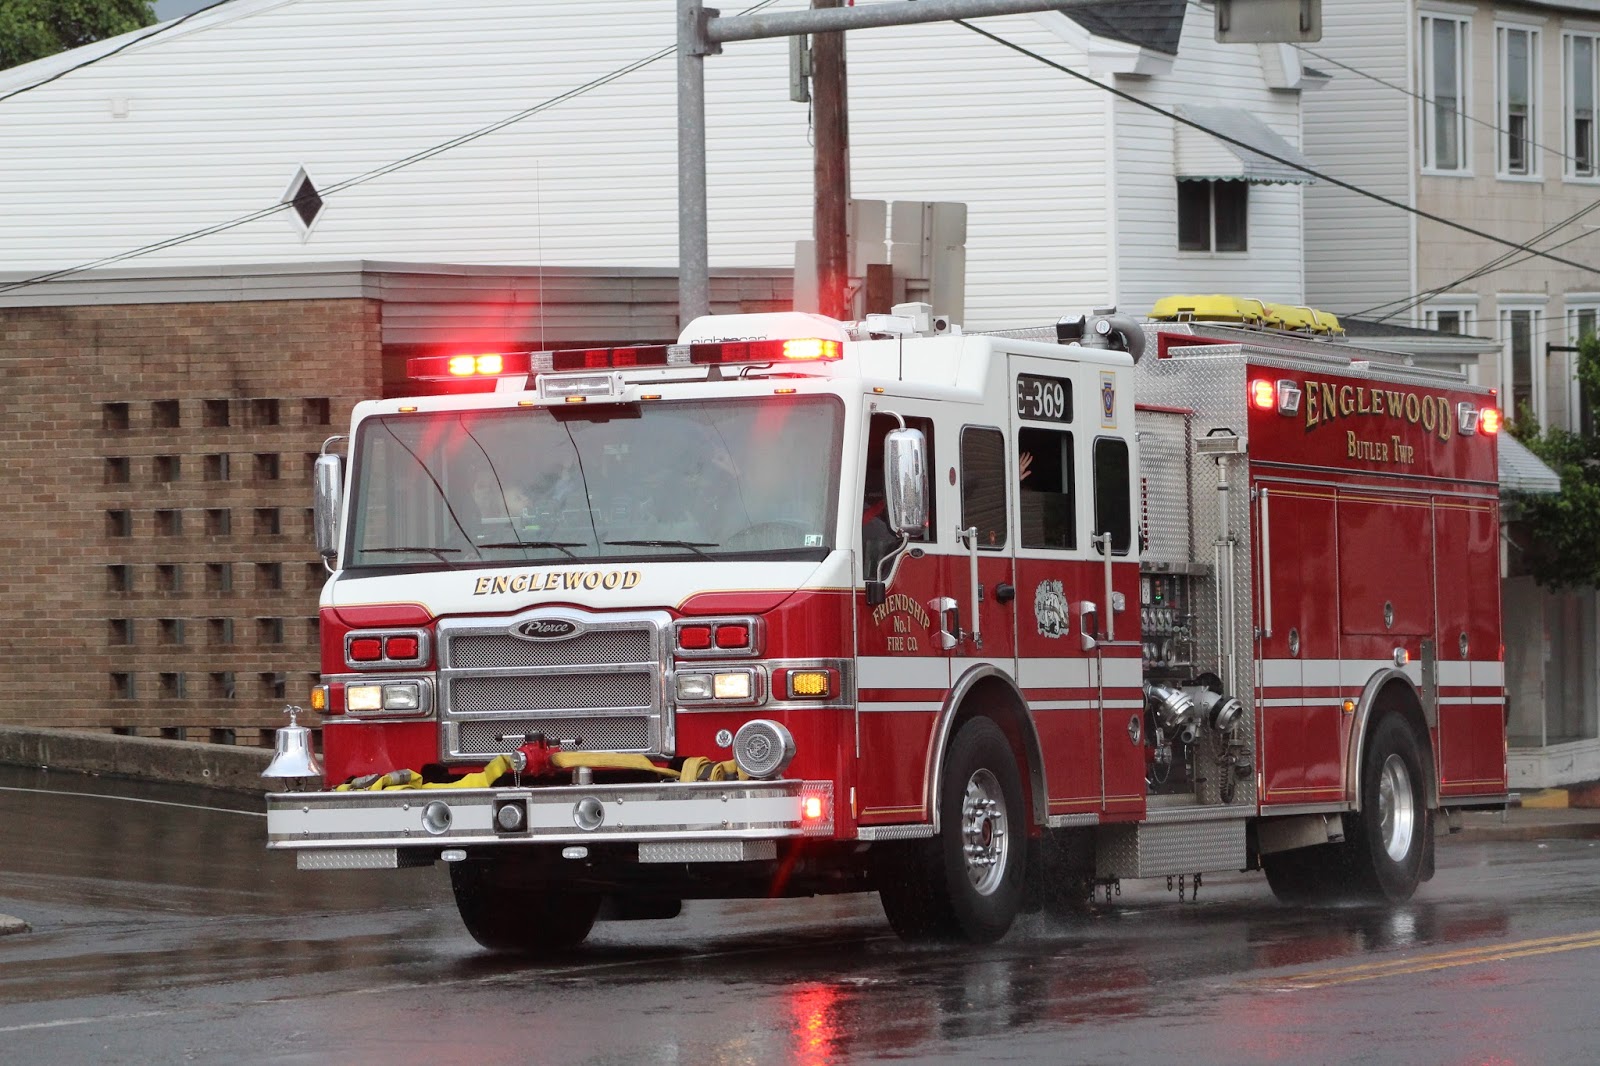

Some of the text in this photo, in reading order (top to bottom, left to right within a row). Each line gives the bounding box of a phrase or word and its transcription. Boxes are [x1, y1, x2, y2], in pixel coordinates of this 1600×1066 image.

[1305, 380, 1451, 442] ENGLEWOOD
[1346, 430, 1389, 462] BUTLER
[473, 570, 642, 596] ENGLEWOOD
[872, 593, 931, 631] FRIENDSHIP
[524, 621, 569, 635] Pierce
[887, 636, 904, 651] FIRE
